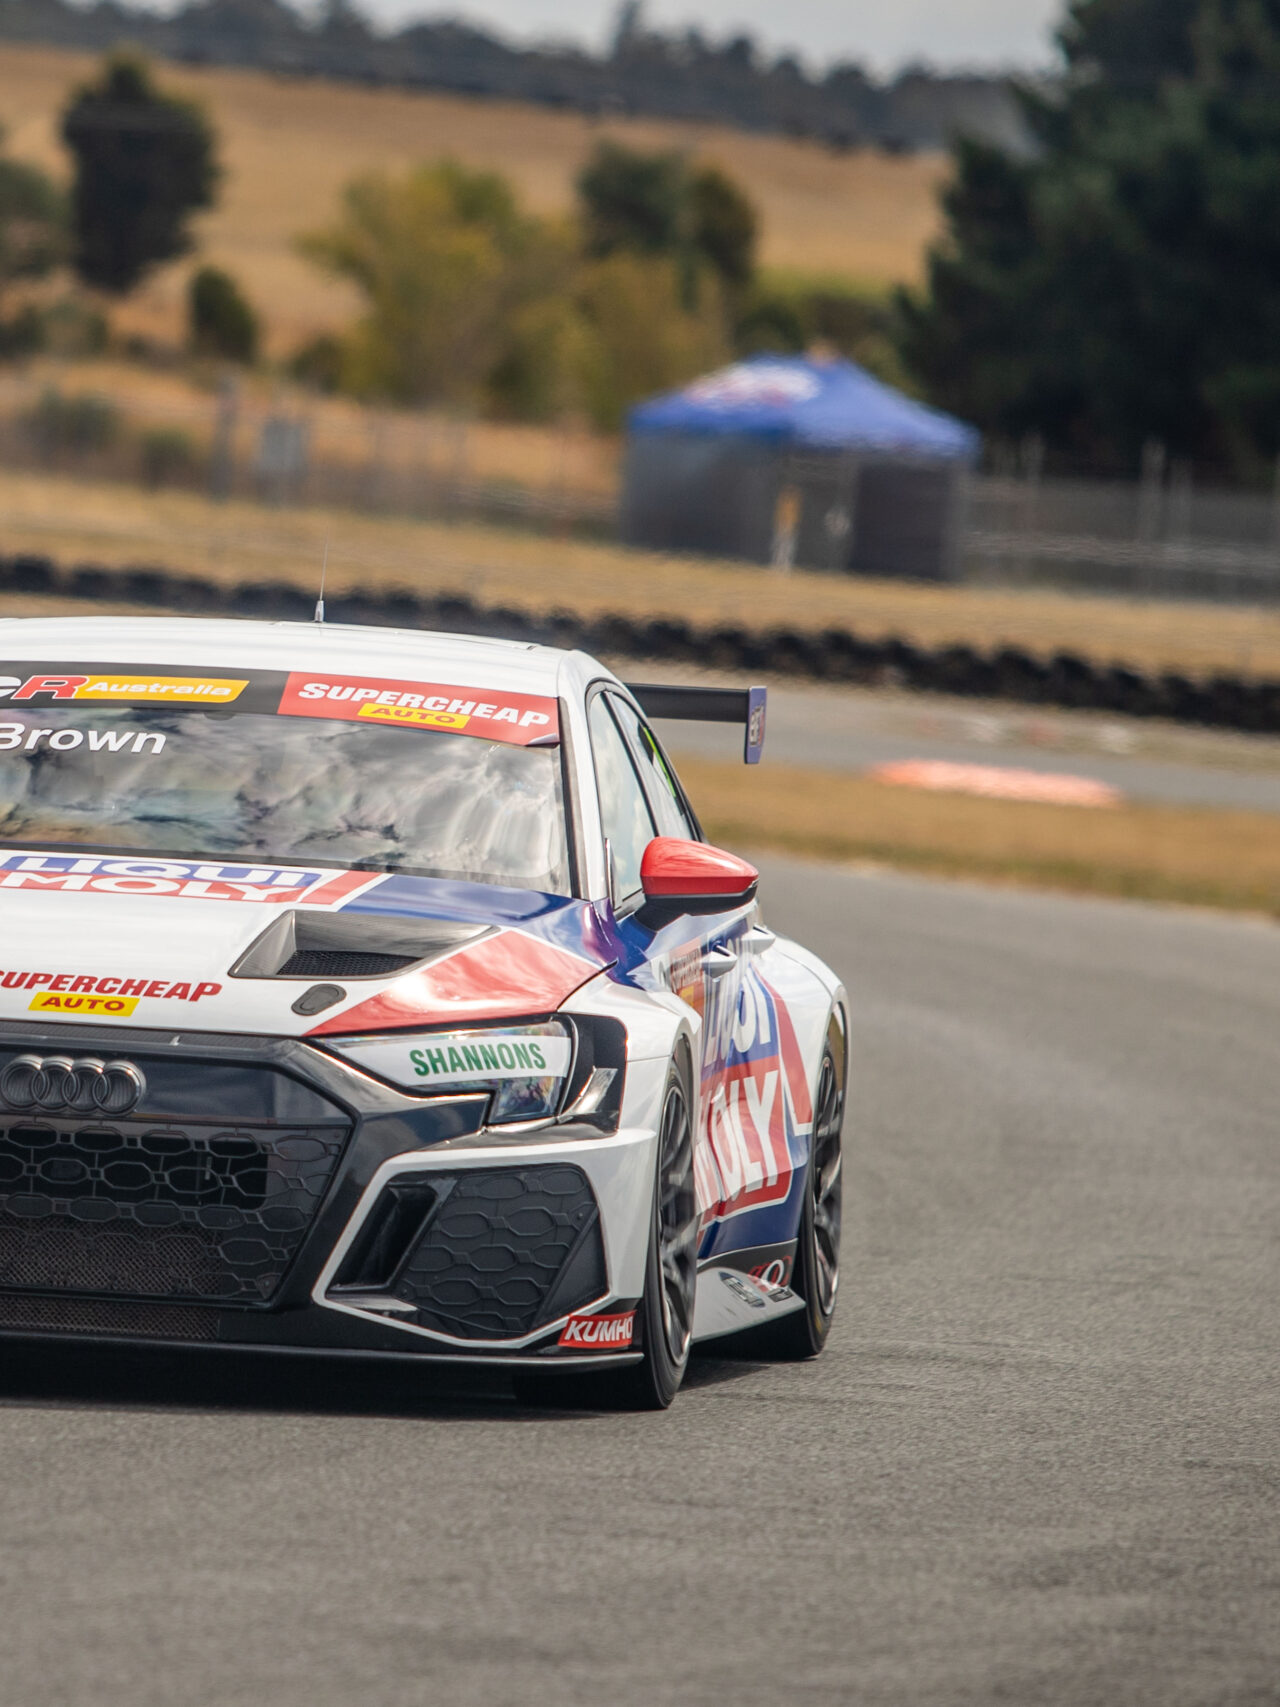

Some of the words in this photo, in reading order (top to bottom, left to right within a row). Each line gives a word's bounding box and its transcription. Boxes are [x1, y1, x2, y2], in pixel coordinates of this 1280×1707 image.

[86, 681, 232, 697] Australia
[298, 682, 551, 728] SUPERCHEAP
[372, 707, 456, 724] AUTO
[15, 856, 306, 887] LIQUI
[0, 871, 301, 902] MOLY
[40, 995, 126, 1012] AUTO
[409, 1042, 547, 1077] SHANNONS
[564, 1315, 634, 1343] KUMHO
